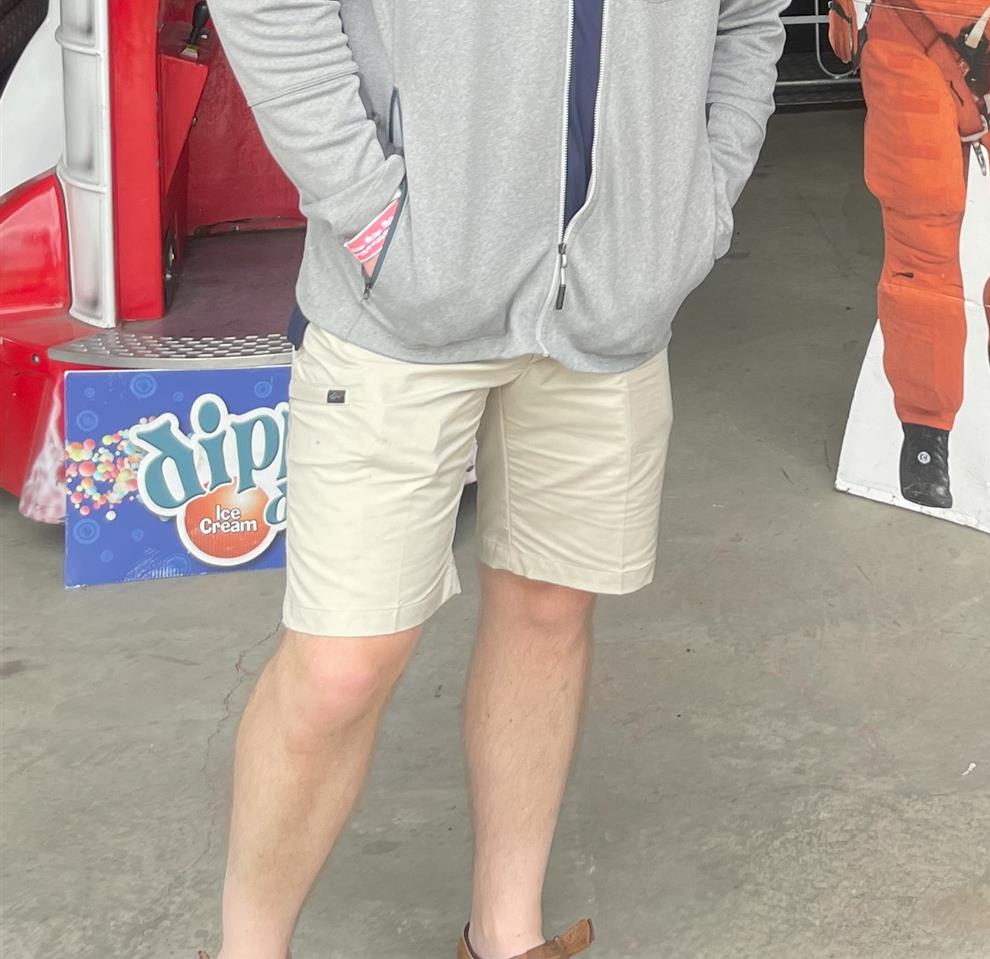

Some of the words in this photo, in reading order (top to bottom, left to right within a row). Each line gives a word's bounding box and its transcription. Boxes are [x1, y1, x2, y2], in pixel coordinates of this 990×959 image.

[136, 400, 288, 508] dip
[216, 504, 240, 520] Ice
[199, 518, 257, 534] Cream
